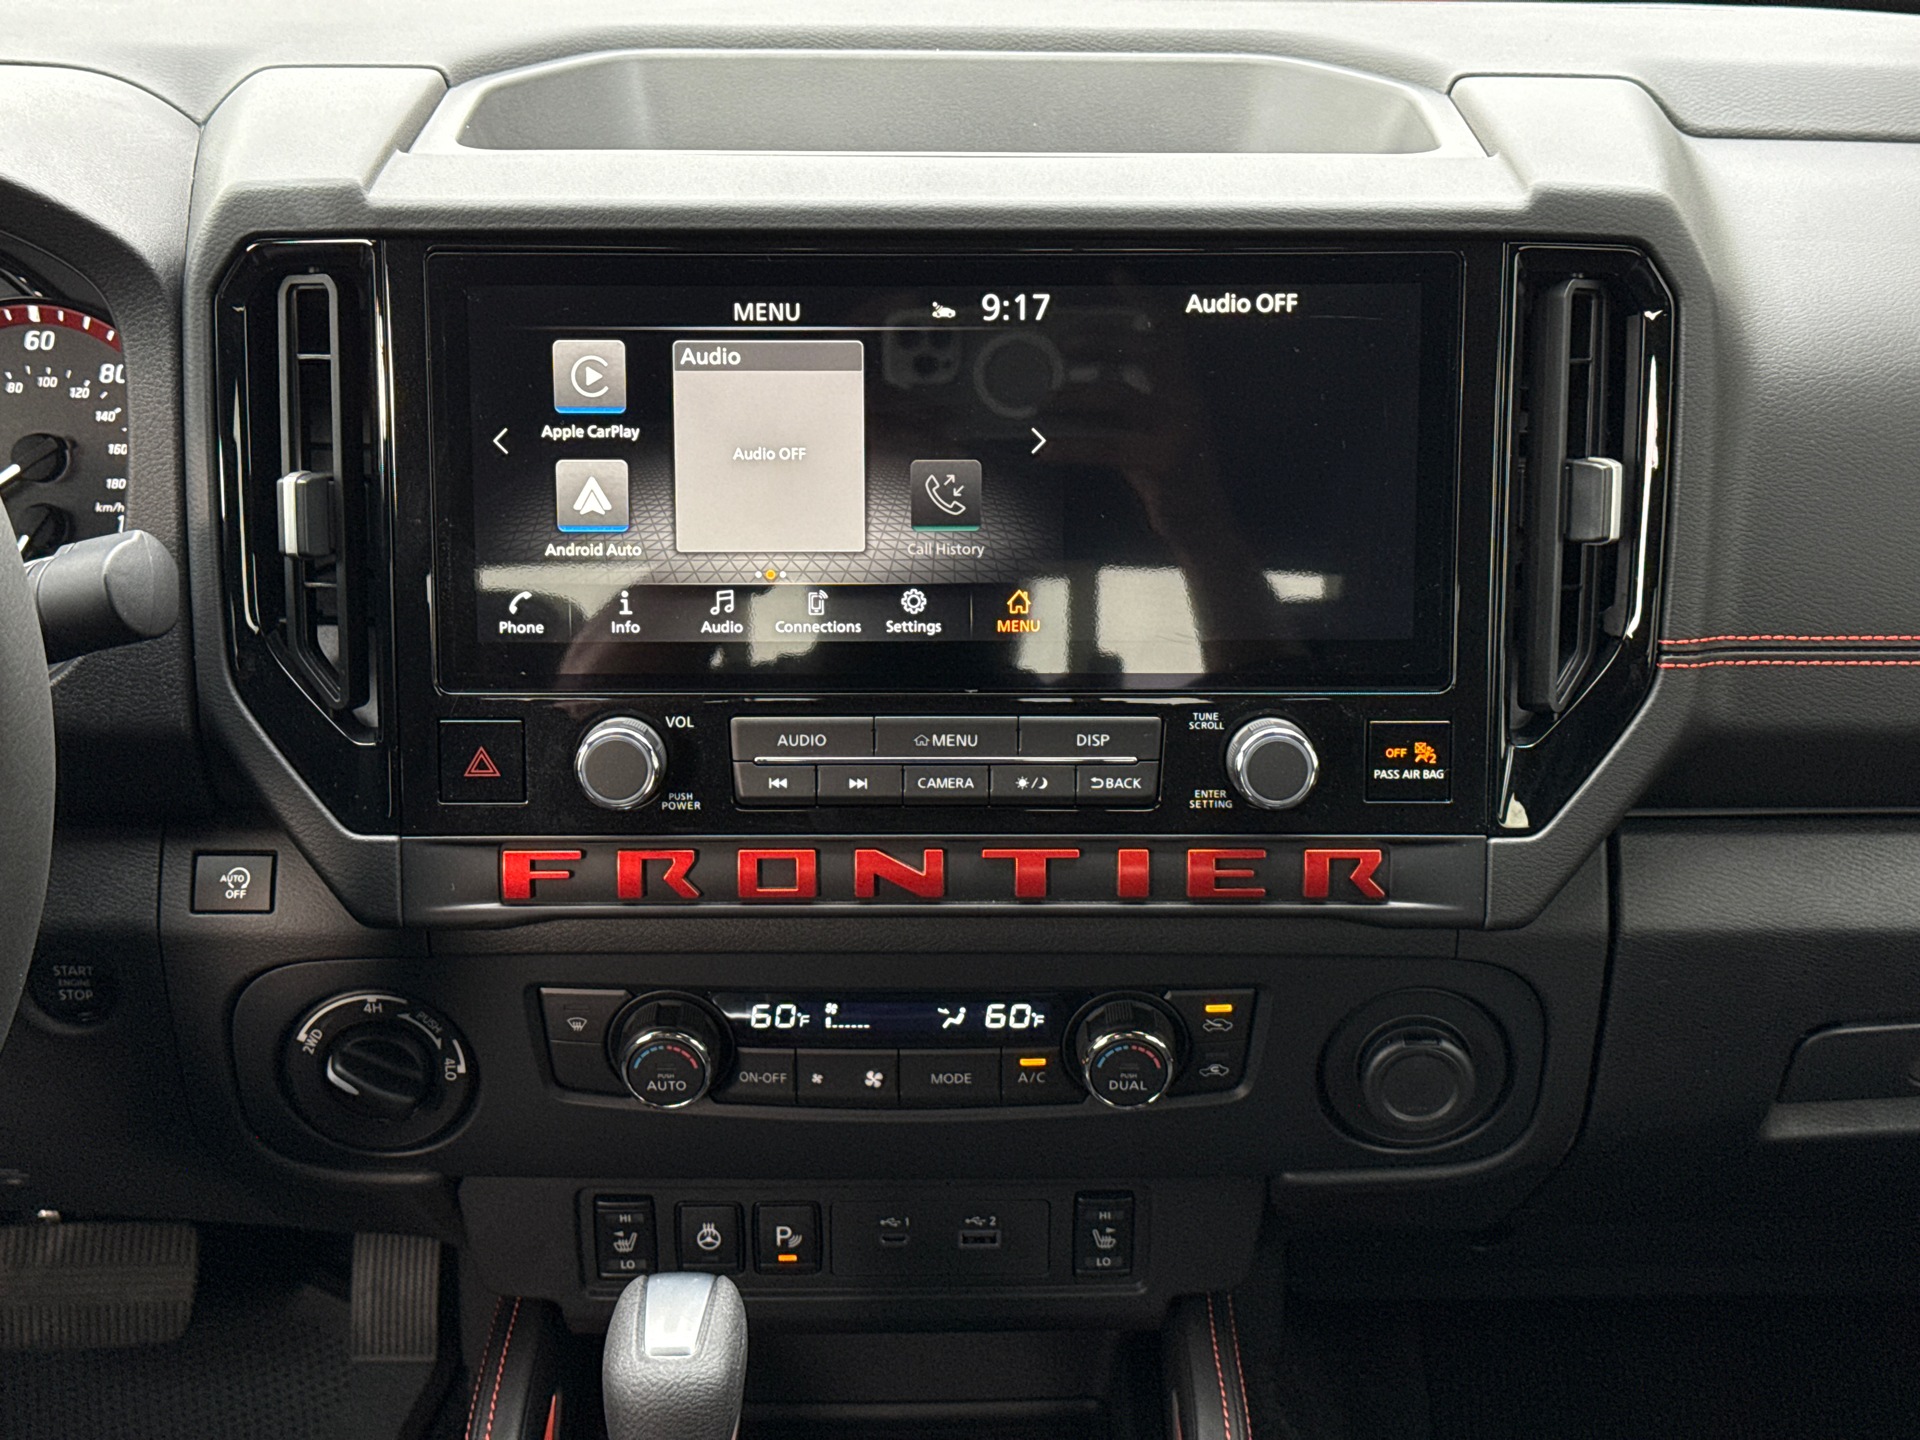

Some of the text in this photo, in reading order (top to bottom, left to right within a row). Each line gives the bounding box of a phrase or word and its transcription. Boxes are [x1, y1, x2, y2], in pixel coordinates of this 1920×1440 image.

[981, 293, 1051, 321] 9:17
[1185, 293, 1299, 314] Audio OFF
[732, 302, 802, 322] MENU
[24, 330, 56, 351] 60
[679, 347, 742, 367] Audio
[6, 381, 24, 394] 80
[37, 376, 58, 389] 100
[69, 386, 91, 399] 120
[94, 410, 117, 422] 140
[541, 424, 640, 441] Apple CarPlay
[107, 443, 128, 455] 160
[732, 447, 807, 461] Audio OFF
[105, 478, 127, 490] 180
[95, 501, 126, 513] km/h
[544, 542, 642, 557] Android Auto
[907, 542, 985, 558] Call History
[498, 619, 545, 635] Phone
[611, 619, 641, 635] Info
[700, 619, 744, 634] Audio
[775, 619, 862, 634] Connections
[885, 619, 943, 635] Settings
[996, 619, 1042, 634] MENU
[664, 715, 695, 729] VOL
[1192, 711, 1220, 722] TUNE
[1188, 721, 1226, 731] SCROLL
[776, 733, 828, 748] AUDIO
[931, 733, 979, 748] MENU
[1075, 733, 1111, 748] DISP
[1385, 747, 1408, 759] OFF
[1373, 768, 1446, 781] PASS AIR BAG
[917, 776, 975, 790] CAMERA
[1105, 776, 1143, 790] BACK
[668, 792, 694, 802] PUSH
[1194, 789, 1228, 799] ENTER
[661, 801, 702, 812] POWER
[1189, 799, 1234, 810] SETTING
[219, 874, 246, 883] AUTO
[502, 848, 1388, 901] FRONTIER
[225, 889, 247, 900] OFF
[52, 964, 94, 977] START
[58, 989, 94, 1001] STOP
[363, 1002, 383, 1014] 4H
[415, 1010, 443, 1034] PUSH
[302, 1028, 323, 1055] 2WD
[444, 1057, 457, 1082] 4LO
[738, 1071, 788, 1085] ON-OFF
[930, 1072, 972, 1086] MODE
[1017, 1071, 1046, 1084] A/C
[646, 1079, 687, 1092] AUTO
[1108, 1079, 1148, 1092] DUAL
[618, 1213, 632, 1224] HI
[988, 1216, 997, 1226] 2
[1098, 1211, 1111, 1221] HI
[619, 1259, 637, 1271] LO
[1095, 1256, 1112, 1268] LO
